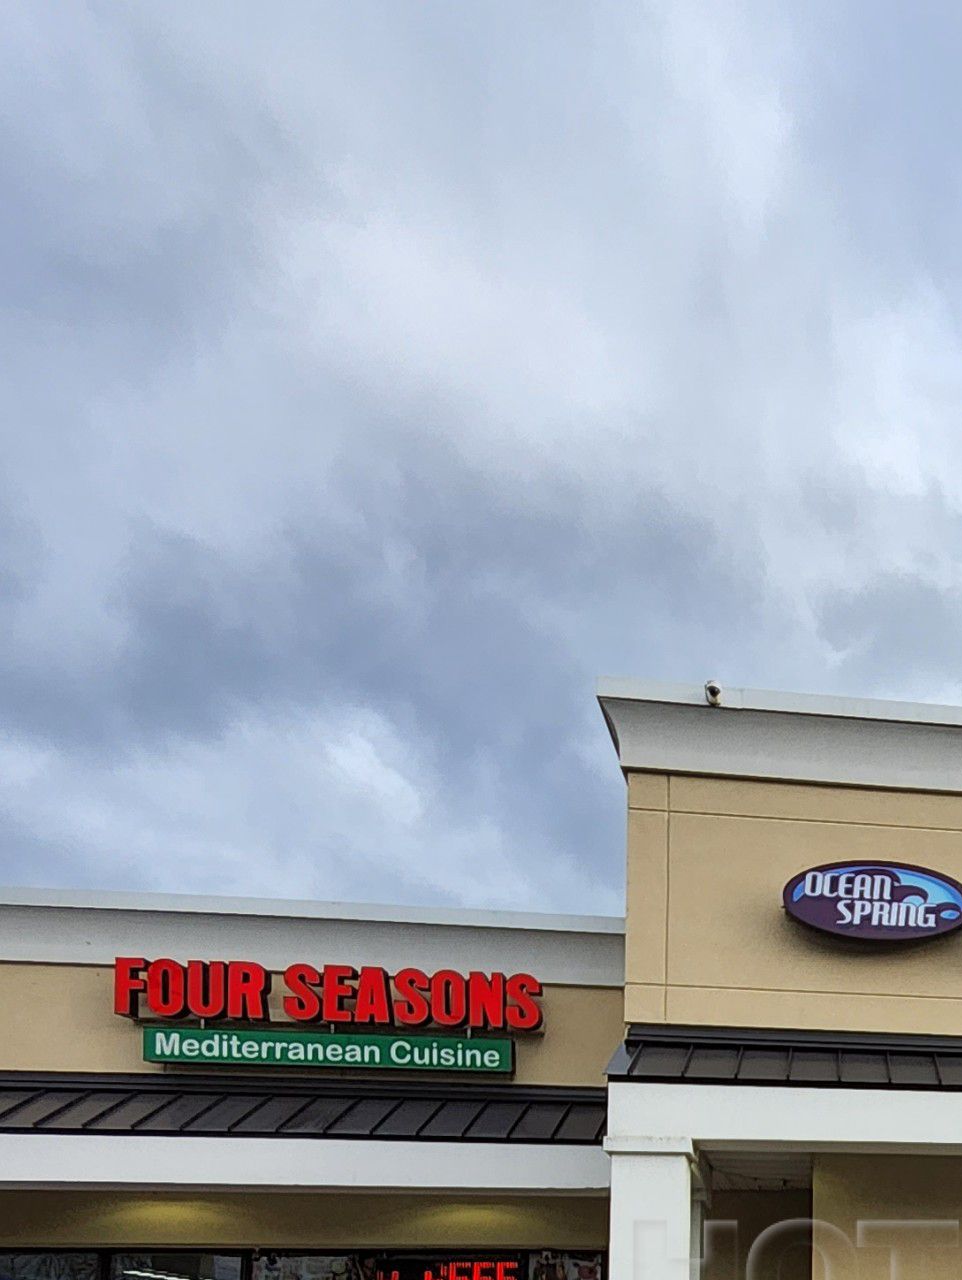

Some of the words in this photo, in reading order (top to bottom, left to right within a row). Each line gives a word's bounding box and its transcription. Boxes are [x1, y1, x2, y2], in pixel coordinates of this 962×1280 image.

[804, 871, 893, 901] OCEAN
[837, 900, 937, 928] SPRING
[114, 956, 269, 1022] FOUR
[283, 963, 544, 1031] SEASONS
[155, 1032, 381, 1064] Mediterranean
[390, 1040, 501, 1068] Cuisine
